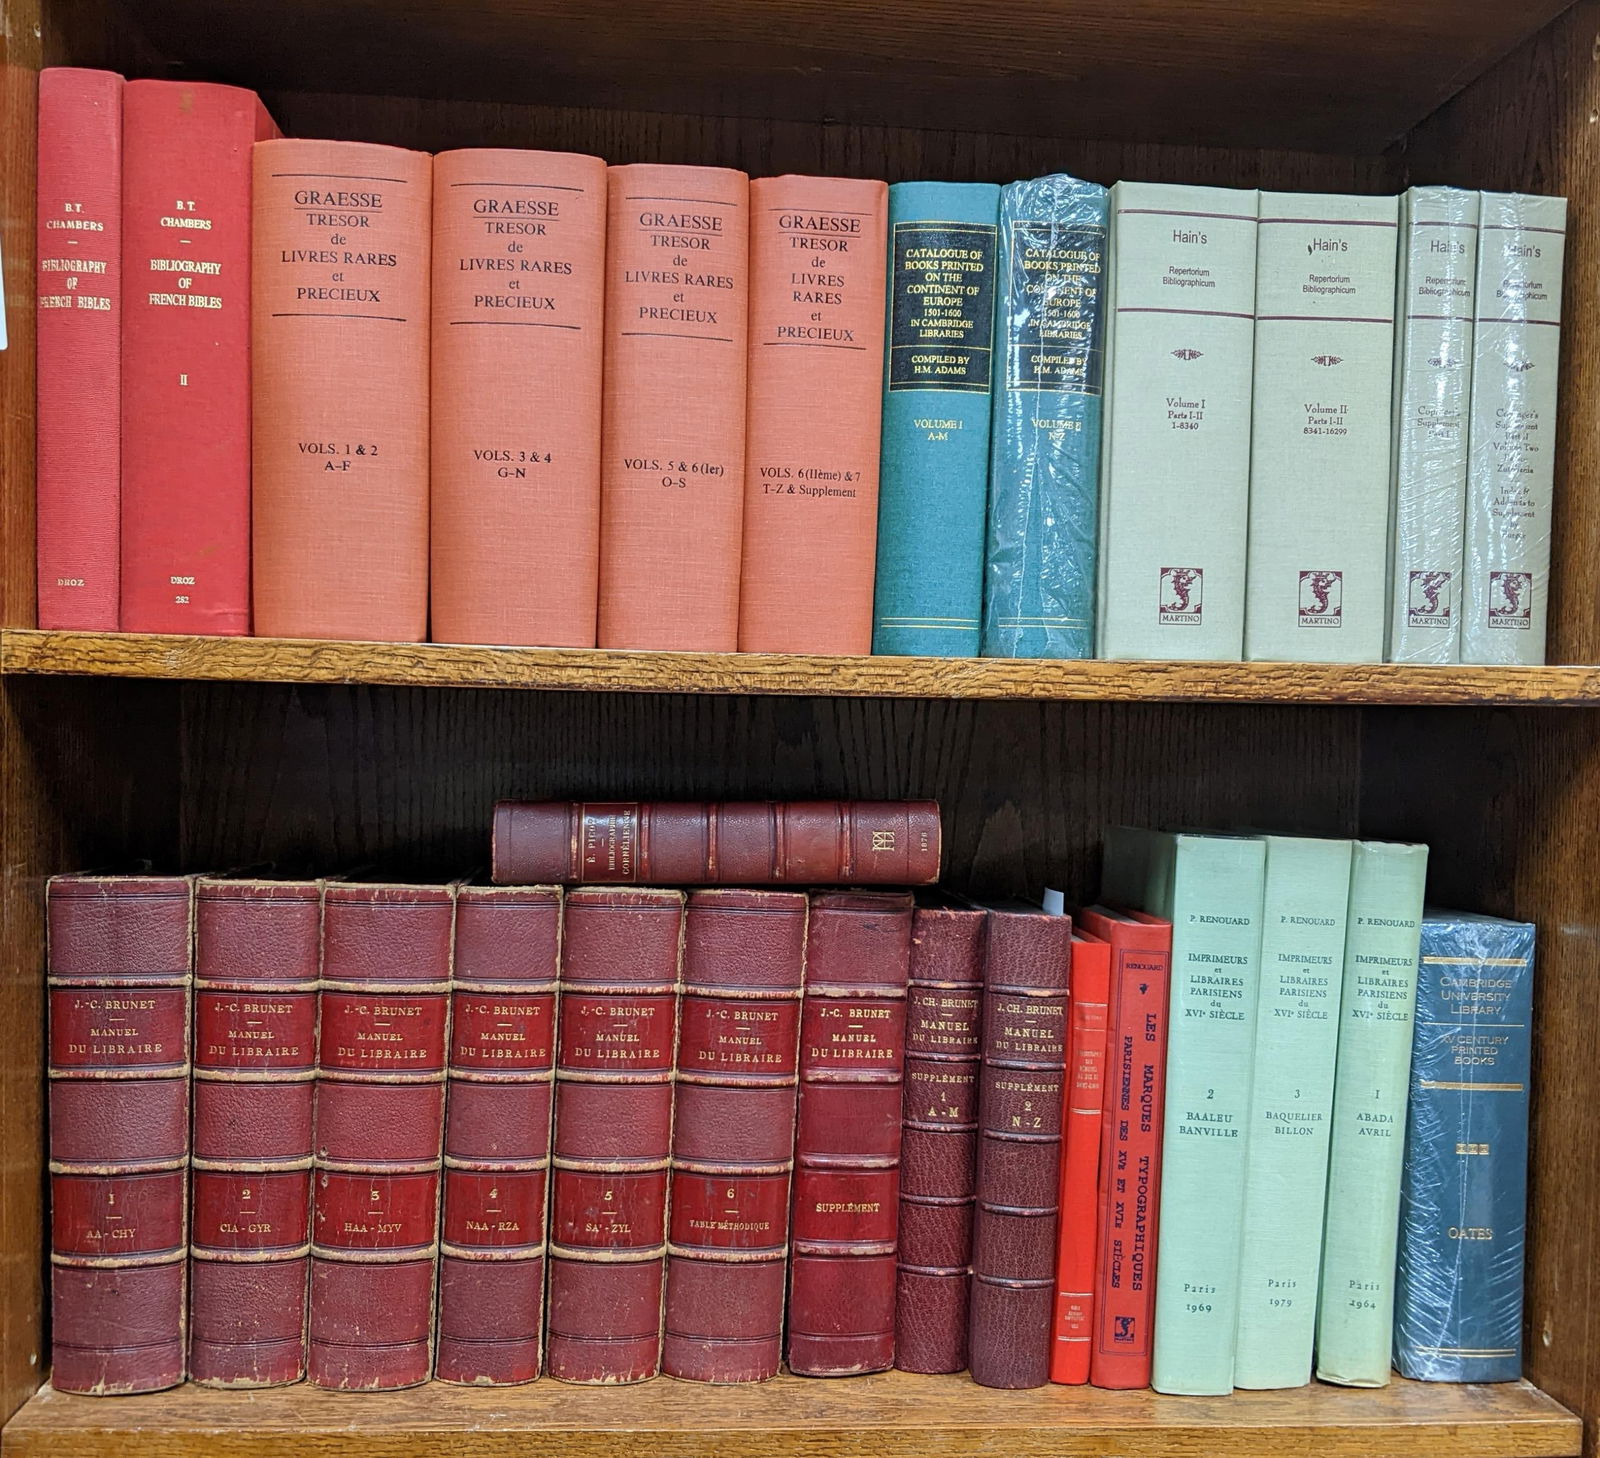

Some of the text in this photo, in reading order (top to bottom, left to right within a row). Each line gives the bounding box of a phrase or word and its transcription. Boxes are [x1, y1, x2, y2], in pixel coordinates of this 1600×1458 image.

[295, 191, 382, 208] GRAESSE
[474, 199, 559, 216] GRAESSE
[160, 217, 211, 230] CHAMBERS
[306, 213, 370, 227] TRESOR
[640, 212, 722, 231] GRAESSE
[779, 215, 861, 232] GRAESSE
[46, 221, 103, 232] CHAMBERS
[485, 222, 546, 235] TRESOR
[331, 234, 346, 245] de
[1173, 229, 1208, 244] Hain's
[508, 241, 523, 253] de
[650, 235, 710, 250] TRESOR
[790, 237, 848, 252] TRESOR
[1313, 238, 1348, 252] Hain's
[282, 251, 397, 267] LIVRES RARES
[906, 249, 983, 260] CATALOGUE OF
[42, 259, 107, 274] BIBLIOGRAPHY
[673, 255, 688, 267] de
[812, 257, 826, 268] de
[905, 261, 983, 272] BOOKS PRINTED
[1024, 261, 1059, 271] BOOKS
[150, 259, 221, 275] BIBLIOGRAPHY
[460, 259, 572, 275] LIVRES RARES
[1169, 266, 1210, 277] Repertorium
[178, 277, 192, 289] OF
[625, 271, 733, 289] LIVRES RARES
[792, 273, 845, 287] LIVRES
[925, 273, 962, 282] ON THE
[1162, 276, 1216, 288] Bibliographicum
[1309, 274, 1350, 284] Repertorium
[297, 288, 380, 302] PRECIEUX
[907, 285, 979, 296] CONTINENT OF
[1302, 284, 1356, 295] Bibliographicum
[149, 293, 222, 309] FRENCH BIBLES
[474, 295, 555, 310] PRECIEUX
[793, 291, 842, 305] RARES
[923, 297, 963, 306] EUROPE
[78, 298, 111, 310] BIBLES
[639, 307, 718, 323] PRECIEUX
[924, 309, 962, 317] 1501-1600
[922, 319, 973, 329] CAMBRIDGE
[777, 326, 854, 342] PRECIEUX
[920, 330, 964, 338] LIBRARIES
[912, 355, 956, 364] COMPILED
[935, 366, 966, 375] ADAMS
[1166, 398, 1200, 409] Volume
[1304, 404, 1338, 415] Volume
[914, 420, 957, 429] VOLUME
[1303, 427, 1348, 436] 8341-16299
[298, 443, 339, 455] VOLS.
[474, 450, 514, 462] VOLS.
[624, 459, 663, 471] VOLS.
[760, 467, 794, 478] VOLS.
[799, 485, 856, 498] Supplement
[171, 576, 195, 585] DROZ
[1162, 614, 1200, 623] MARTINO
[1301, 617, 1340, 626] MARTINO
[1411, 617, 1449, 626] MARTINO
[1491, 618, 1529, 626] MARTINO
[1200, 916, 1250, 926] RENOUARD
[1290, 916, 1336, 926] RENOUARD
[1367, 918, 1416, 928] RENOUARD
[1188, 953, 1248, 965] IMPRIMEURS
[1278, 953, 1333, 965] IMPRIMEURS
[1355, 955, 1413, 966] IMPRIMEURS
[1190, 975, 1244, 986] LIBRAIRES
[1279, 975, 1328, 986] LIBRAIRES
[1357, 977, 1408, 988] LIBRAIRES
[1440, 977, 1512, 988] CAMBRIDGE
[1190, 988, 1242, 999] PARISIENS
[1279, 988, 1327, 998] PARISIENS
[1357, 989, 1407, 1000] PARISIENS
[1441, 990, 1511, 1001] UNIVERSITY
[105, 1000, 155, 1010] BRUNET
[243, 1004, 293, 1013] BRUNET
[942, 998, 978, 1008] BRUNET
[373, 1006, 423, 1016] BRUNET
[493, 1006, 540, 1015] BRUNET
[610, 1007, 655, 1016] BRUNET
[849, 1009, 891, 1019] BRUNET
[1026, 1004, 1063, 1015] BRUNET
[1209, 1007, 1245, 1020] SIÈCLE
[1298, 1007, 1328, 1020] SIÈCLE
[1376, 1008, 1408, 1021] SIÈCLE
[1451, 1004, 1501, 1015] LIBRARY
[734, 1011, 778, 1021] BRUNET
[921, 1020, 969, 1031] MANUEL
[90, 1029, 139, 1037] MANUEL
[228, 1030, 275, 1039] MANUEL
[357, 1032, 403, 1041] MANUEL
[480, 1032, 526, 1041] MANUEL
[595, 1033, 640, 1042] MANUEL
[832, 1034, 876, 1043] MANUEL
[1004, 1027, 1054, 1039] MANUEL
[719, 1036, 762, 1045] MANUEL
[930, 1035, 978, 1045] LIBRAIRE
[1457, 1036, 1509, 1045] CENTURY
[68, 1043, 162, 1054] DU LIBRAIRE
[209, 1046, 299, 1057] DU LIBRAIRE
[338, 1047, 427, 1058] DU LIBRAIRE
[460, 1047, 546, 1058] DU LIBRAIRE
[1015, 1042, 1063, 1052] LIBRAIRE
[1451, 1046, 1498, 1055] PRINTED
[575, 1048, 660, 1058] DU LIBRAIRE
[699, 1051, 782, 1063] DU LIBRAIRE
[811, 1048, 893, 1059] DU LIBRAIRE
[1455, 1057, 1495, 1065] BOOKS
[911, 1072, 975, 1083] SUPPLÉMENT
[995, 1081, 1060, 1092] SUPPLÉMENT
[1186, 1112, 1233, 1123] BAALEU
[1265, 1111, 1323, 1124] BAQUELIER
[1356, 1113, 1394, 1123] ABADA
[1179, 1126, 1238, 1137] BANVILLE
[1275, 1126, 1314, 1135] BILLON
[1358, 1128, 1391, 1137] AVRIL
[1132, 1013, 1156, 1291] LES MARQUES TYPOGRAPHIQUES
[1112, 1036, 1133, 1288] PARISIENNES DES ET SIÈCLES
[815, 1202, 881, 1214] SUPPLÉMENT
[718, 1219, 770, 1232] MÉTHODIQUE
[1448, 1227, 1493, 1240] OATES
[1184, 1284, 1216, 1294] Paris
[1268, 1279, 1297, 1288] Paris
[1350, 1280, 1380, 1291] Paris
